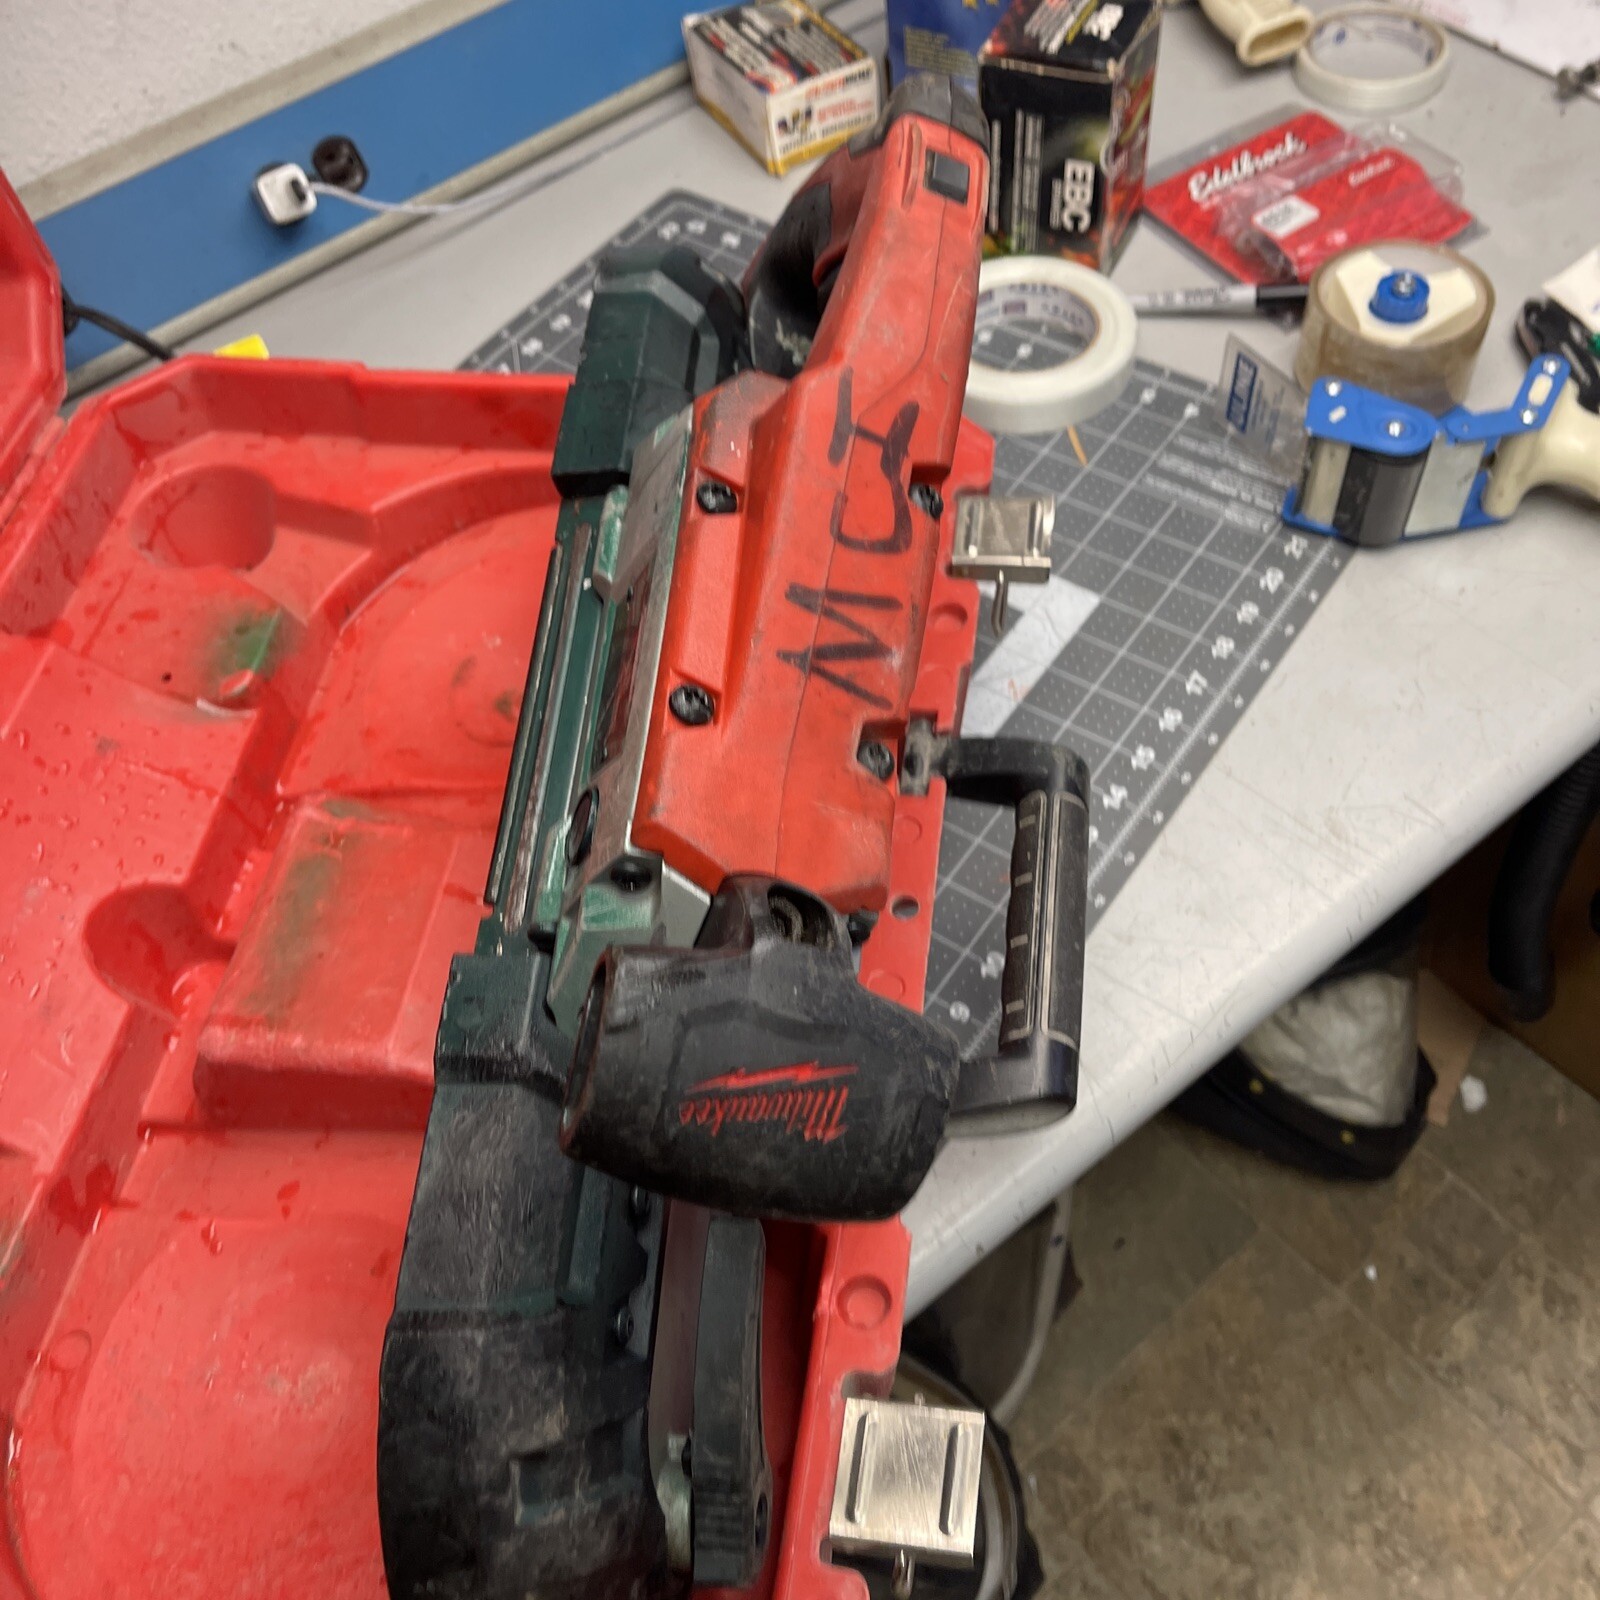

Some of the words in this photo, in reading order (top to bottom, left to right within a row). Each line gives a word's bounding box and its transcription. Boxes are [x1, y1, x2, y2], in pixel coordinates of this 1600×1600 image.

[1062, 158, 1095, 232] EBC
[1189, 131, 1306, 200] Edelbrock
[679, 1087, 848, 1143] Milwaukee
